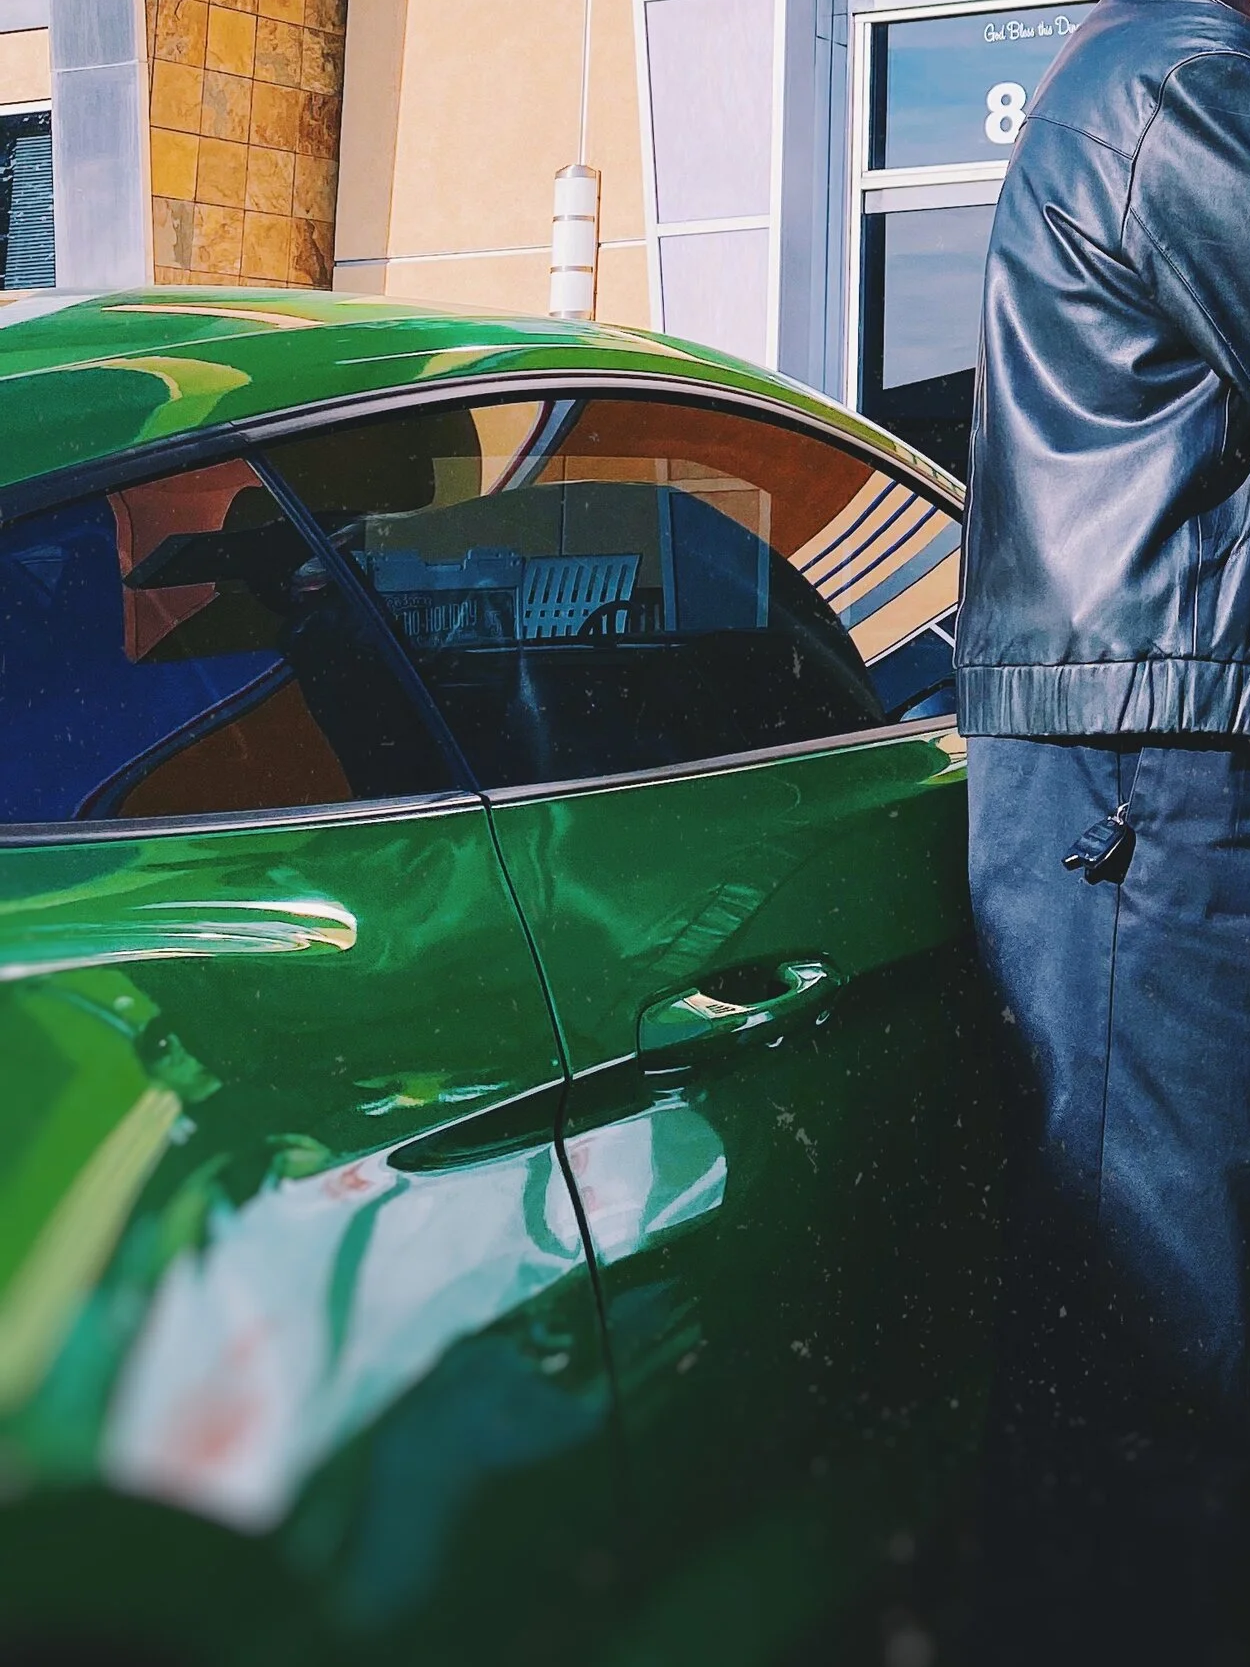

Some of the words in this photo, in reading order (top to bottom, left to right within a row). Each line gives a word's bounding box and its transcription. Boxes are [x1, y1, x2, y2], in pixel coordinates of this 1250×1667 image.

[984, 22, 1006, 43] God
[1006, 20, 1035, 40] Bless
[1037, 20, 1053, 37] this
